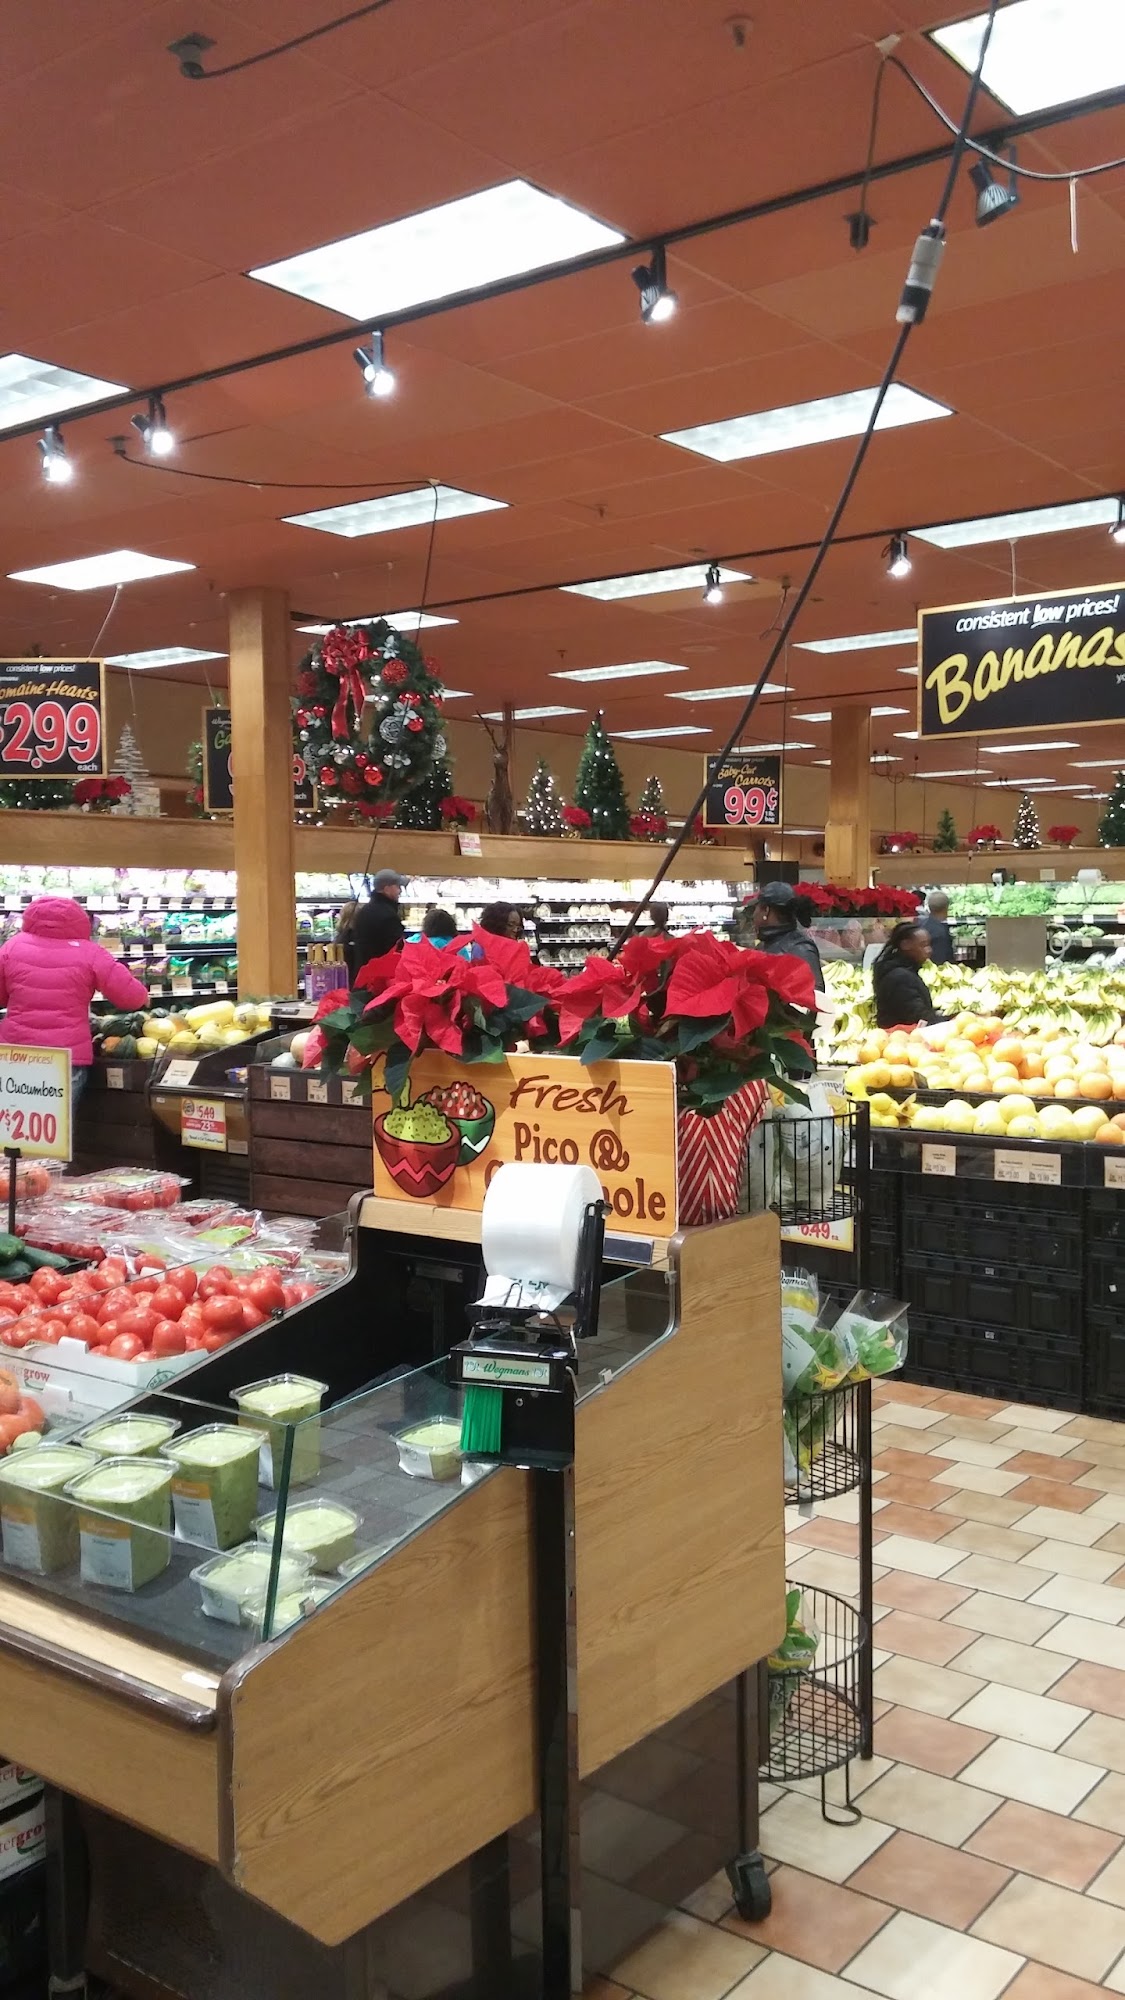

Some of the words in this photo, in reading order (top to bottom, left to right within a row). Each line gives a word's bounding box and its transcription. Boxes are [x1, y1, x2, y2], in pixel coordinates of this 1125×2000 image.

[956, 606, 1030, 633] consistent
[1031, 603, 1064, 629] low
[1064, 594, 1120, 623] prices!
[5, 665, 39, 673] consistent
[39, 665, 53, 674] low
[53, 664, 76, 674] prices!
[925, 626, 1125, 725] Bananas
[0, 681, 46, 700] omaine
[46, 680, 98, 701] Hearts
[77, 763, 98, 772] each
[734, 774, 776, 788] Carrots
[10, 1050, 28, 1064] low
[28, 1055, 54, 1065] prices!
[5, 1077, 64, 1098] Cucumbers
[509, 1075, 634, 1117] Fresh
[513, 1121, 580, 1165] Pico
[483, 1360, 530, 1379] Wegmans
